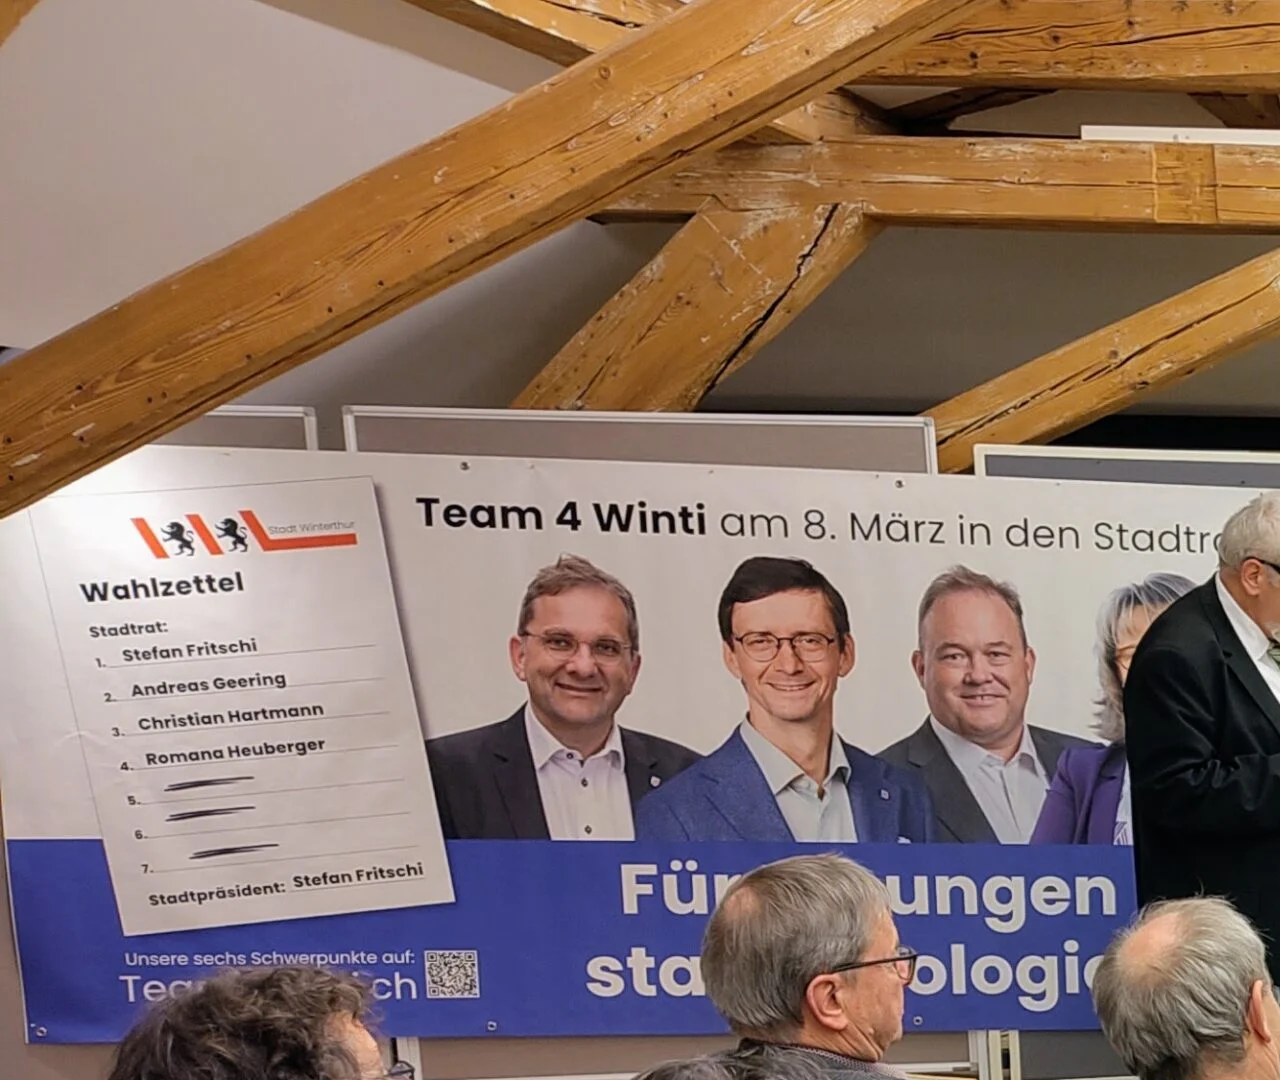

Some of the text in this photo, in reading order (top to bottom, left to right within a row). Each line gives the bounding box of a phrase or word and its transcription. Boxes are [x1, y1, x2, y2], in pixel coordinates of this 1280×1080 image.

[268, 520, 355, 536] Stadt Winterthur
[416, 498, 1222, 554] Team 4 Winti am 8. März in den Stadtr
[80, 571, 244, 603] Wahlzettel
[89, 621, 169, 638] Stadtrat:
[122, 644, 184, 663] Stefan
[186, 638, 257, 657] Fritschi
[104, 673, 286, 703] 2. Andreas Geering
[112, 703, 324, 737] 3. Christian Hartmann
[120, 738, 325, 772] 4. Romana Heuberger
[127, 795, 141, 806] 5.
[134, 830, 148, 840] 6.
[141, 864, 154, 875] 7.
[148, 862, 424, 906] Stadtpräsident: Stefan Fritschi
[886, 874, 1117, 933] ungen
[124, 949, 415, 968] Unsere sechs Schwerpunkte auf:
[585, 946, 706, 998] sta
